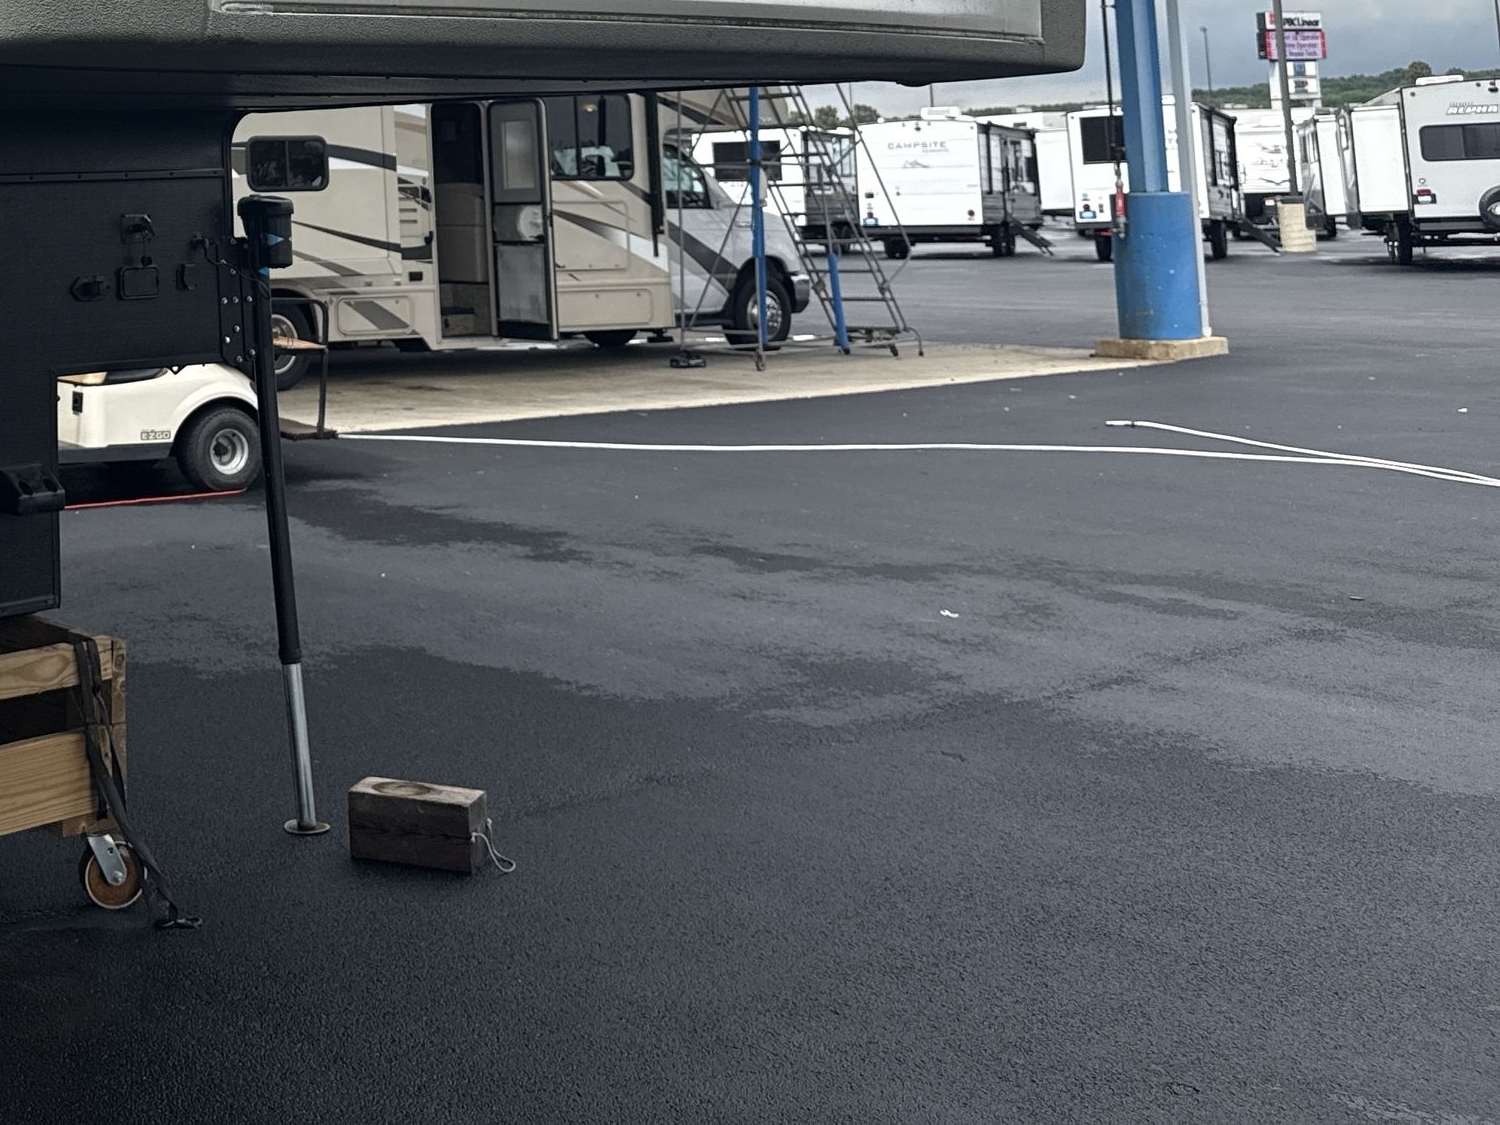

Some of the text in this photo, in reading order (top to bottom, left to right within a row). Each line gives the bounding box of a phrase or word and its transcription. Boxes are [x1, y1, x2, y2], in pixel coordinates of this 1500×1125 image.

[1446, 104, 1498, 115] ALPHA
[887, 140, 947, 150] CAMPSITE
[141, 431, 171, 440] EZGO
